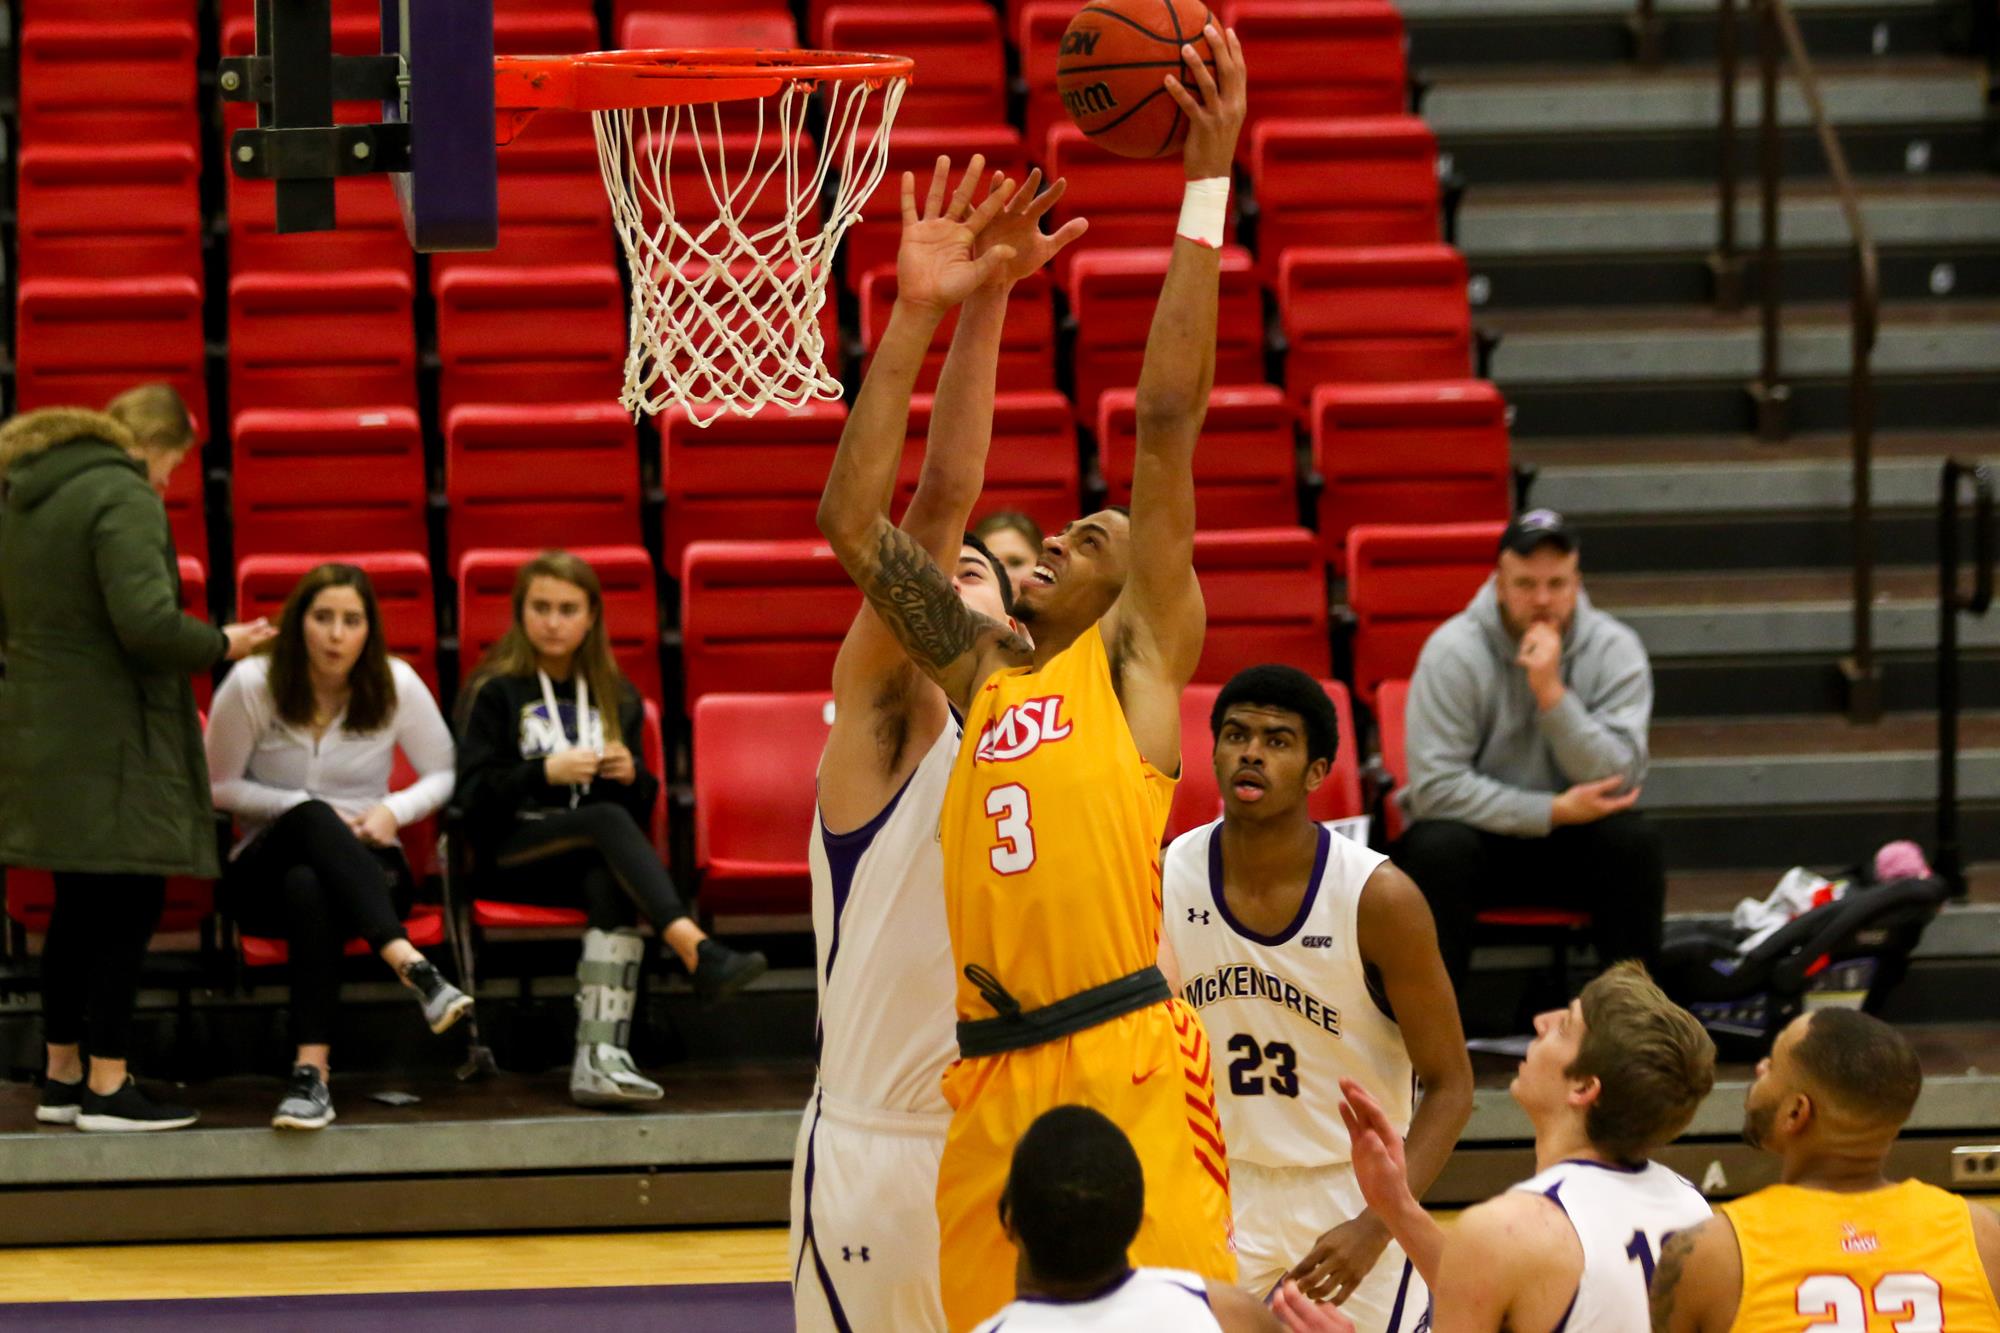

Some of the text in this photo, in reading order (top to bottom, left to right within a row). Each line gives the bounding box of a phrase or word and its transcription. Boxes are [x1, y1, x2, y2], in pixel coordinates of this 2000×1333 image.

[984, 781, 1036, 876] 3
[1182, 964, 1342, 1039] McKENDREE
[1228, 1033, 1299, 1099] 23
[1702, 1159, 1727, 1191] A
